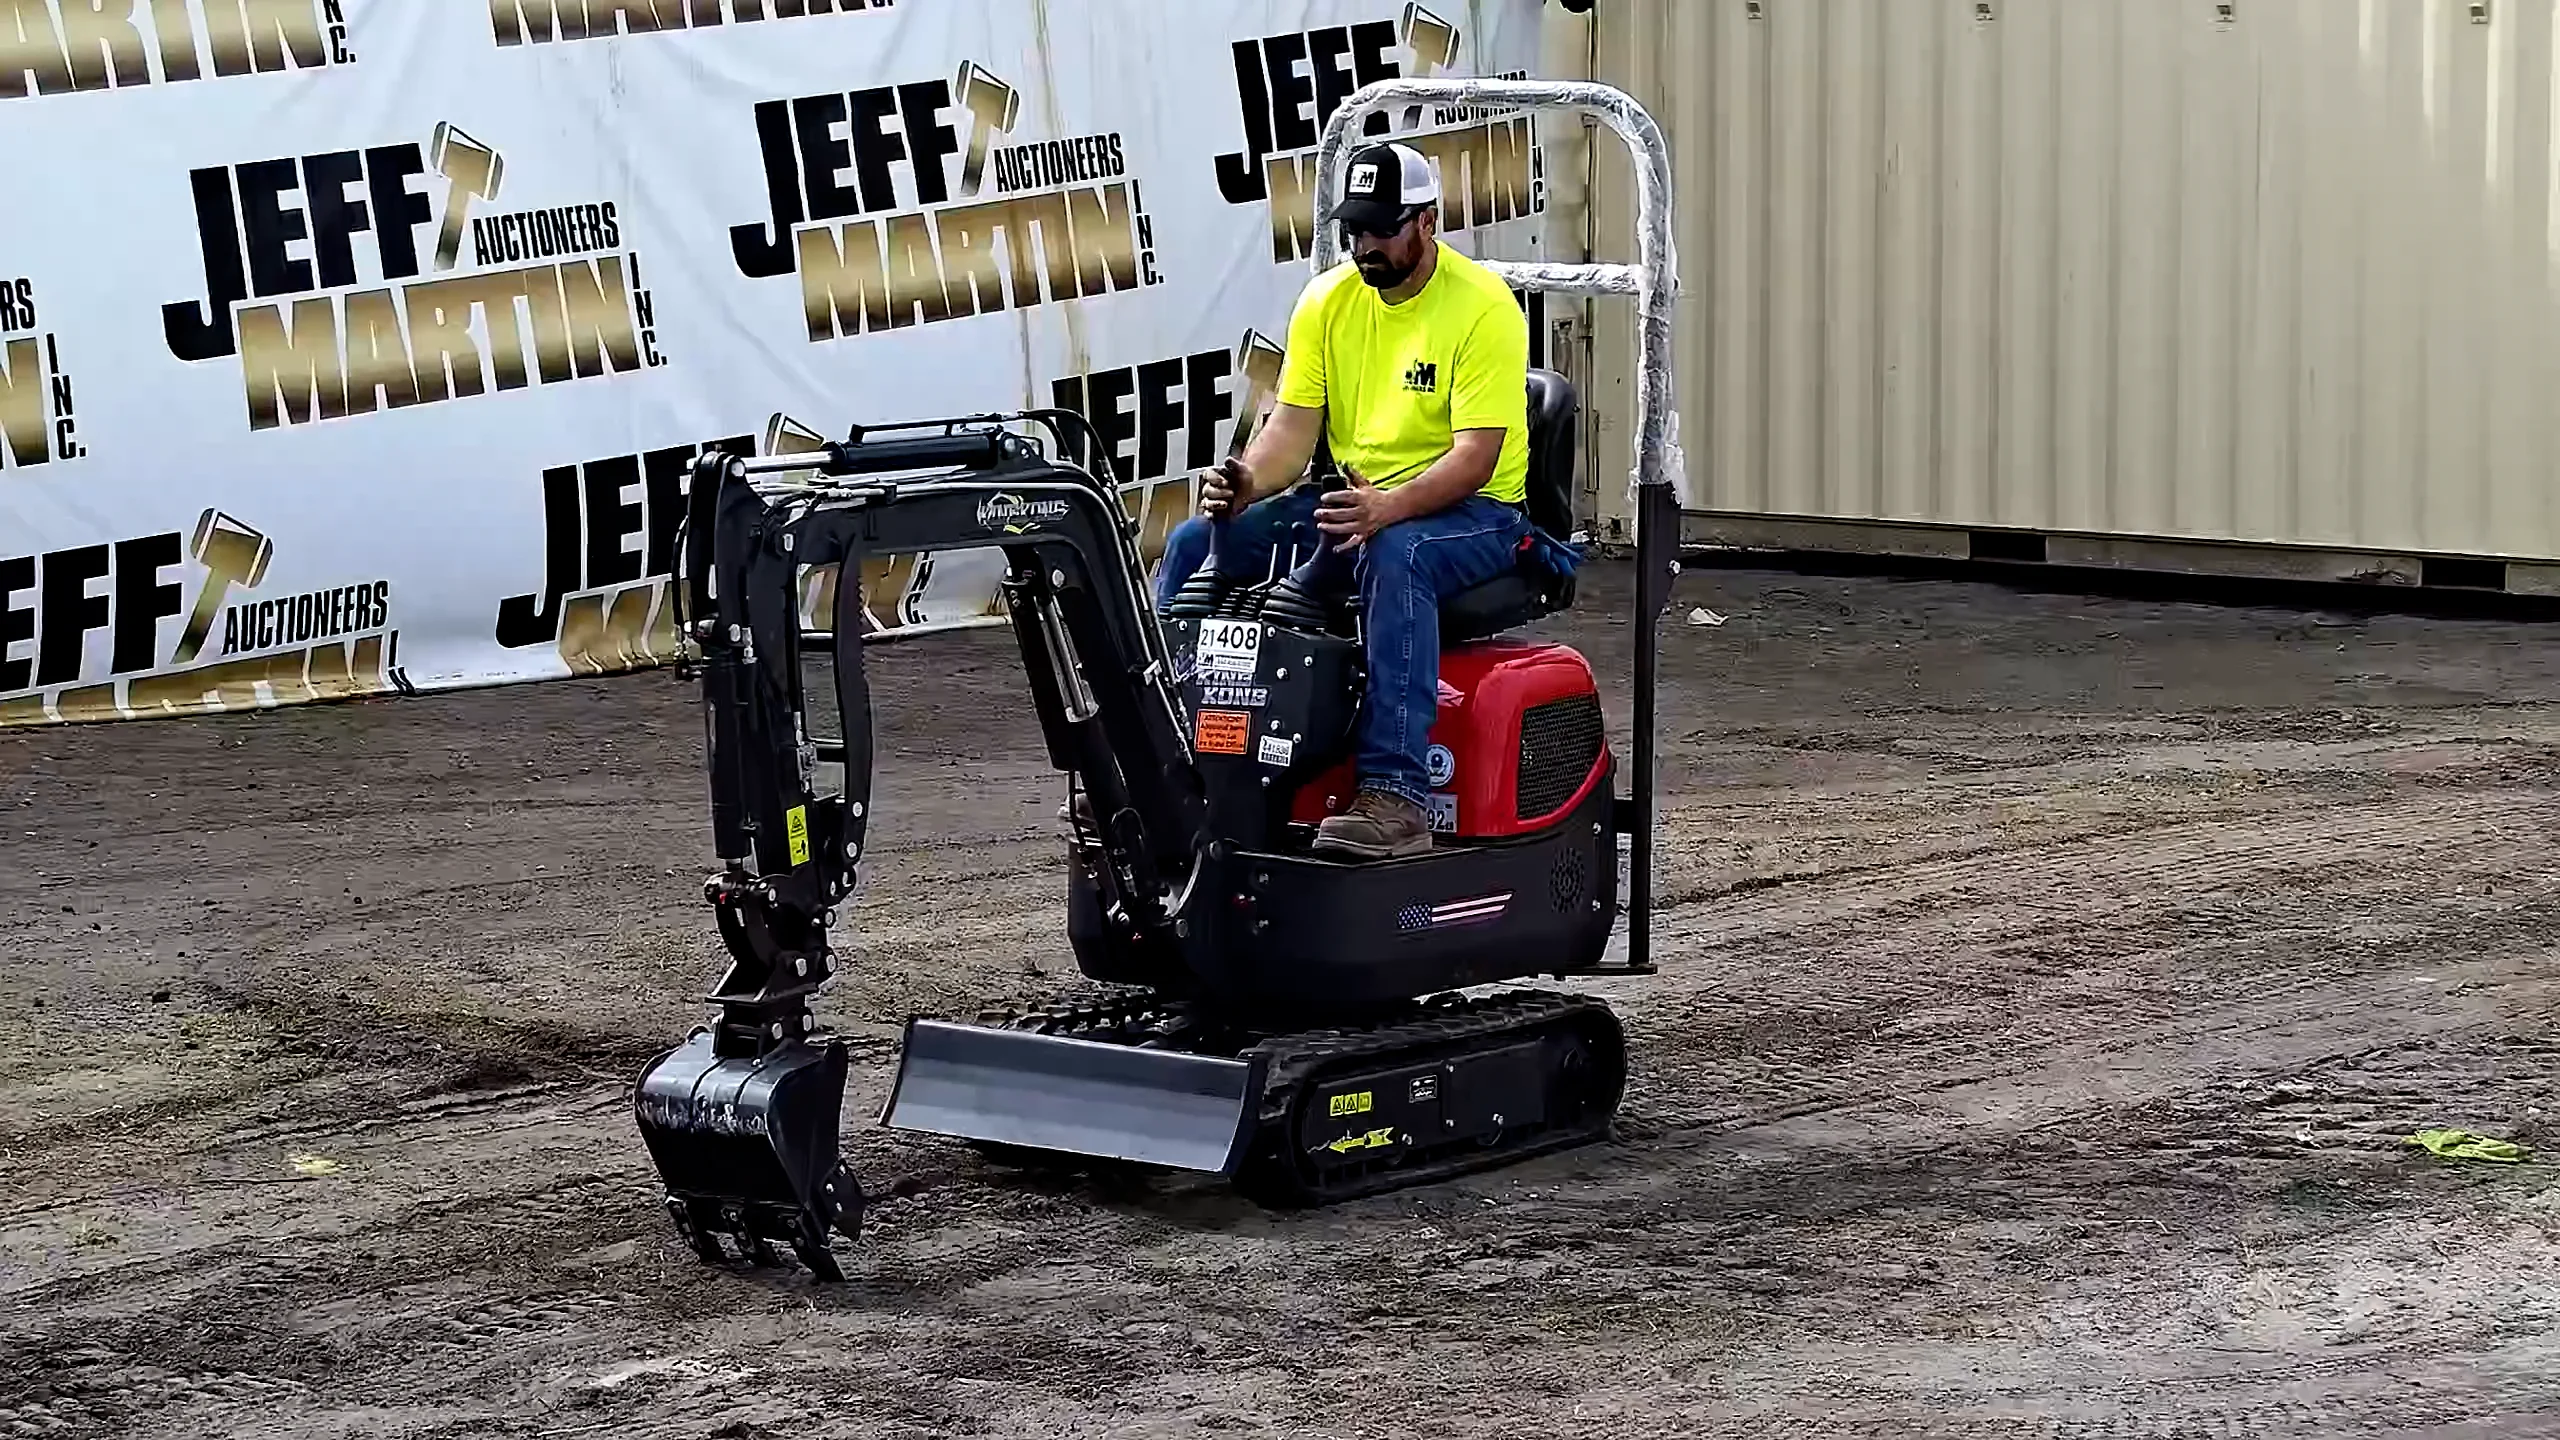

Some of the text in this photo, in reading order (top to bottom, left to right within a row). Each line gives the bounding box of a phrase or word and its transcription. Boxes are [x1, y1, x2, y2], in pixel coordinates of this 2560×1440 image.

[0, 0, 327, 98] ARTIN
[323, 0, 356, 64] NC.
[995, 132, 1125, 192] AUCTIONEERS
[1214, 20, 1400, 203] JEFF
[473, 202, 619, 266] AUCTIONEERS
[729, 79, 958, 277] JEFF
[1133, 179, 1164, 286] INC.
[162, 143, 432, 360] JEFF
[798, 182, 1137, 341] MARTIN
[238, 256, 641, 430] MARTIN
[628, 252, 668, 368] INC.
[46, 332, 87, 460] INC.
[497, 433, 756, 648] JEF
[0, 532, 182, 692] EFF
[222, 580, 389, 655] AUCTIONEERS
[1217, 625, 1258, 650] 408
[1201, 687, 1268, 706] KONG
